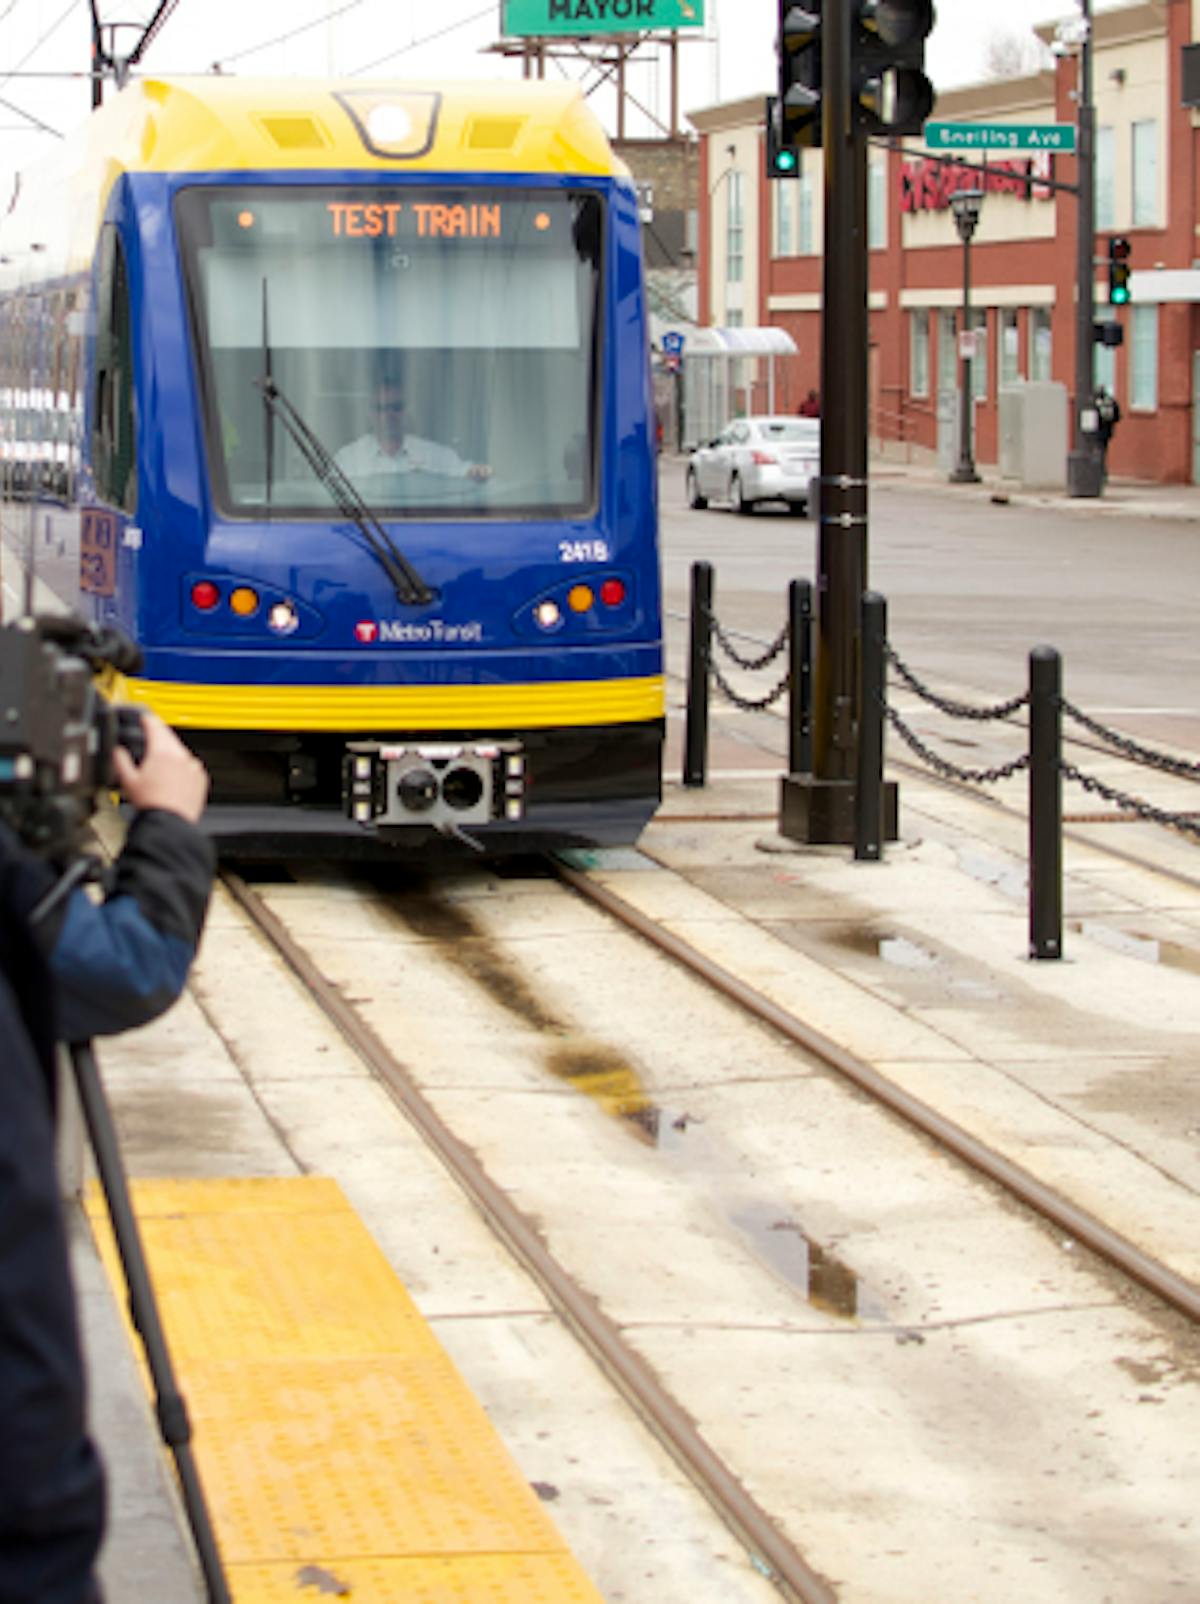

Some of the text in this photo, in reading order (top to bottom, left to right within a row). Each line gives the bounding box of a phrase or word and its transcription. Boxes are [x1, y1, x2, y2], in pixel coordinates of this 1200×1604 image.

[550, 0, 654, 20] MAYOR
[939, 128, 1062, 148] Snelling Ave
[327, 203, 501, 237] TEST TRAIN
